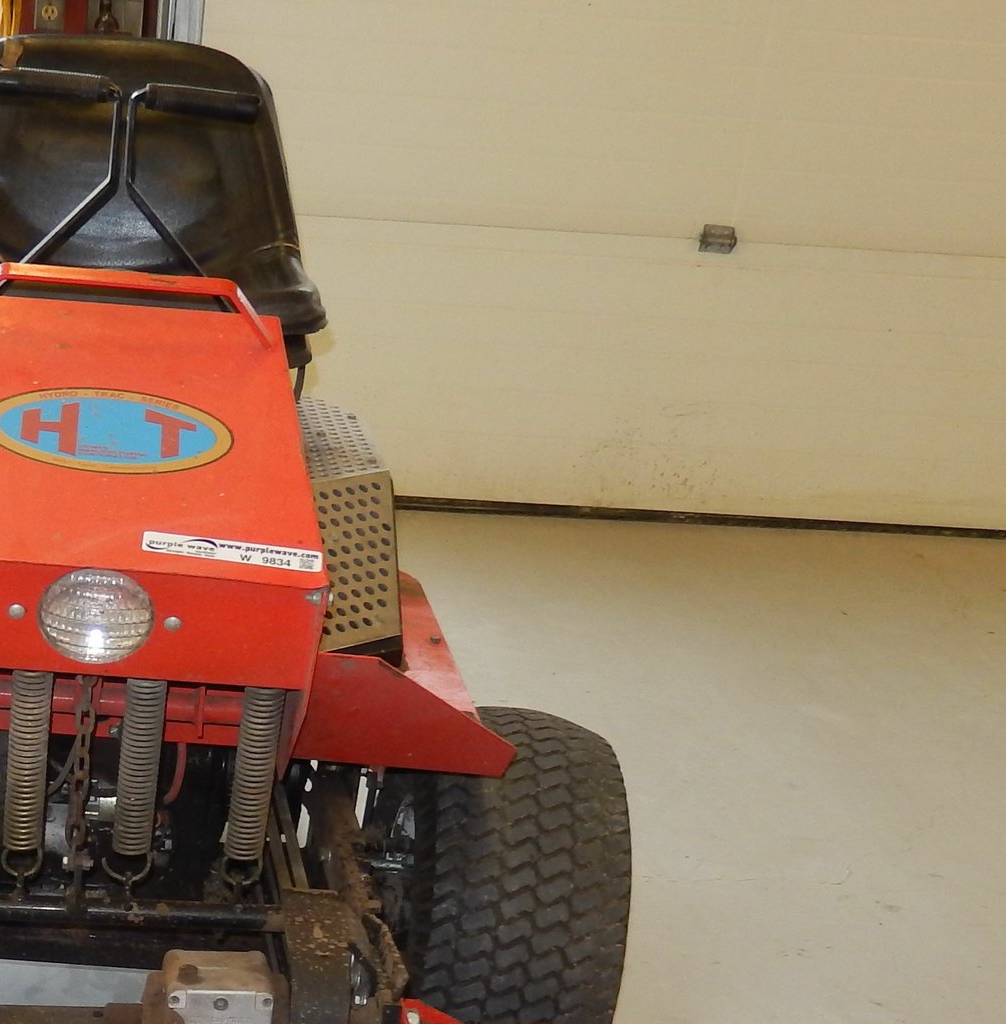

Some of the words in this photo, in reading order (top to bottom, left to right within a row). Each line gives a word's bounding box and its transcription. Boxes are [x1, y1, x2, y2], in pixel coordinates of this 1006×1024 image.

[39, 390, 78, 399] HYDRO
[91, 390, 125, 399] TRAC
[141, 396, 180, 411] SERIES
[19, 402, 80, 456] H
[144, 408, 197, 459] T
[148, 539, 184, 548] purple
[187, 544, 216, 552] wave
[218, 542, 319, 560] www.purplewave.com
[240, 553, 252, 562] W
[261, 556, 291, 567] 9834
